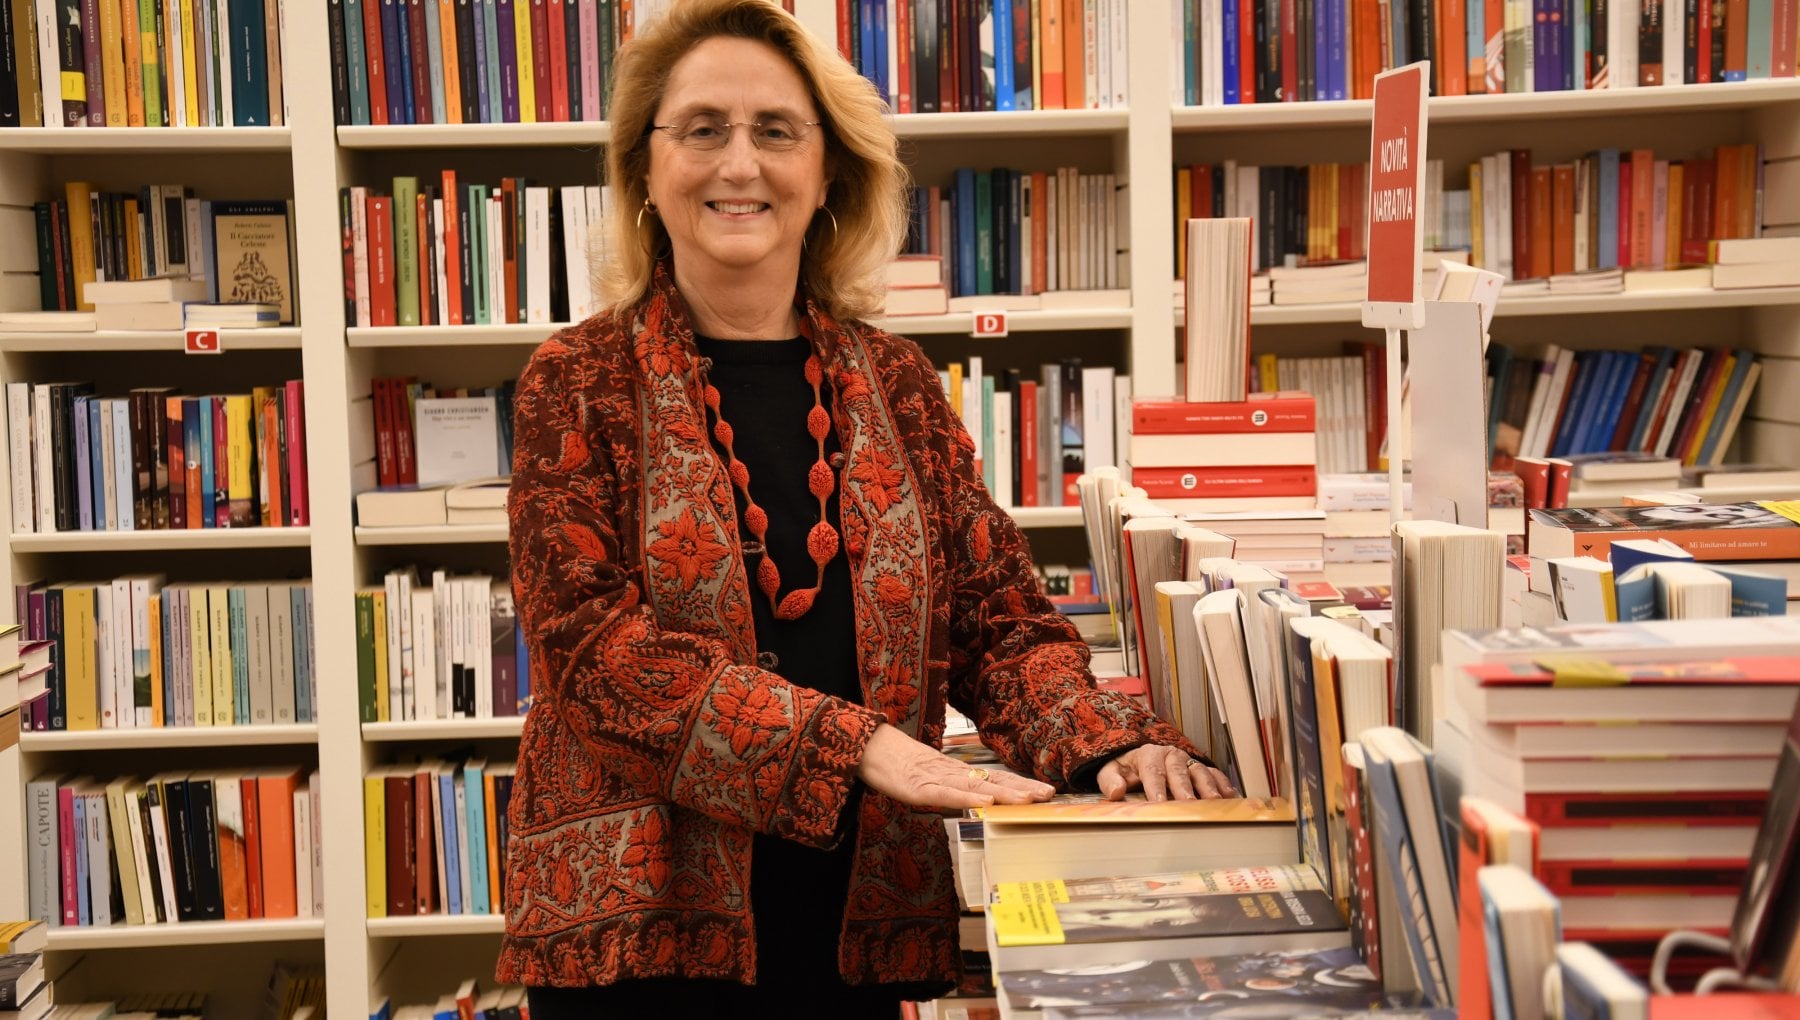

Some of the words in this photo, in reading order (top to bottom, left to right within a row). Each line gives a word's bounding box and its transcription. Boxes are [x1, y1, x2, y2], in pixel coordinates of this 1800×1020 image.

[1380, 126, 1409, 174] NOVITÀ
[1373, 186, 1413, 224] NARRATIVA
[983, 316, 998, 332] D
[195, 333, 210, 348] C
[1689, 541, 1699, 549] Mi
[1700, 540, 1727, 549] limitavo
[1728, 541, 1737, 549] ad
[38, 788, 50, 847] CAPOTE
